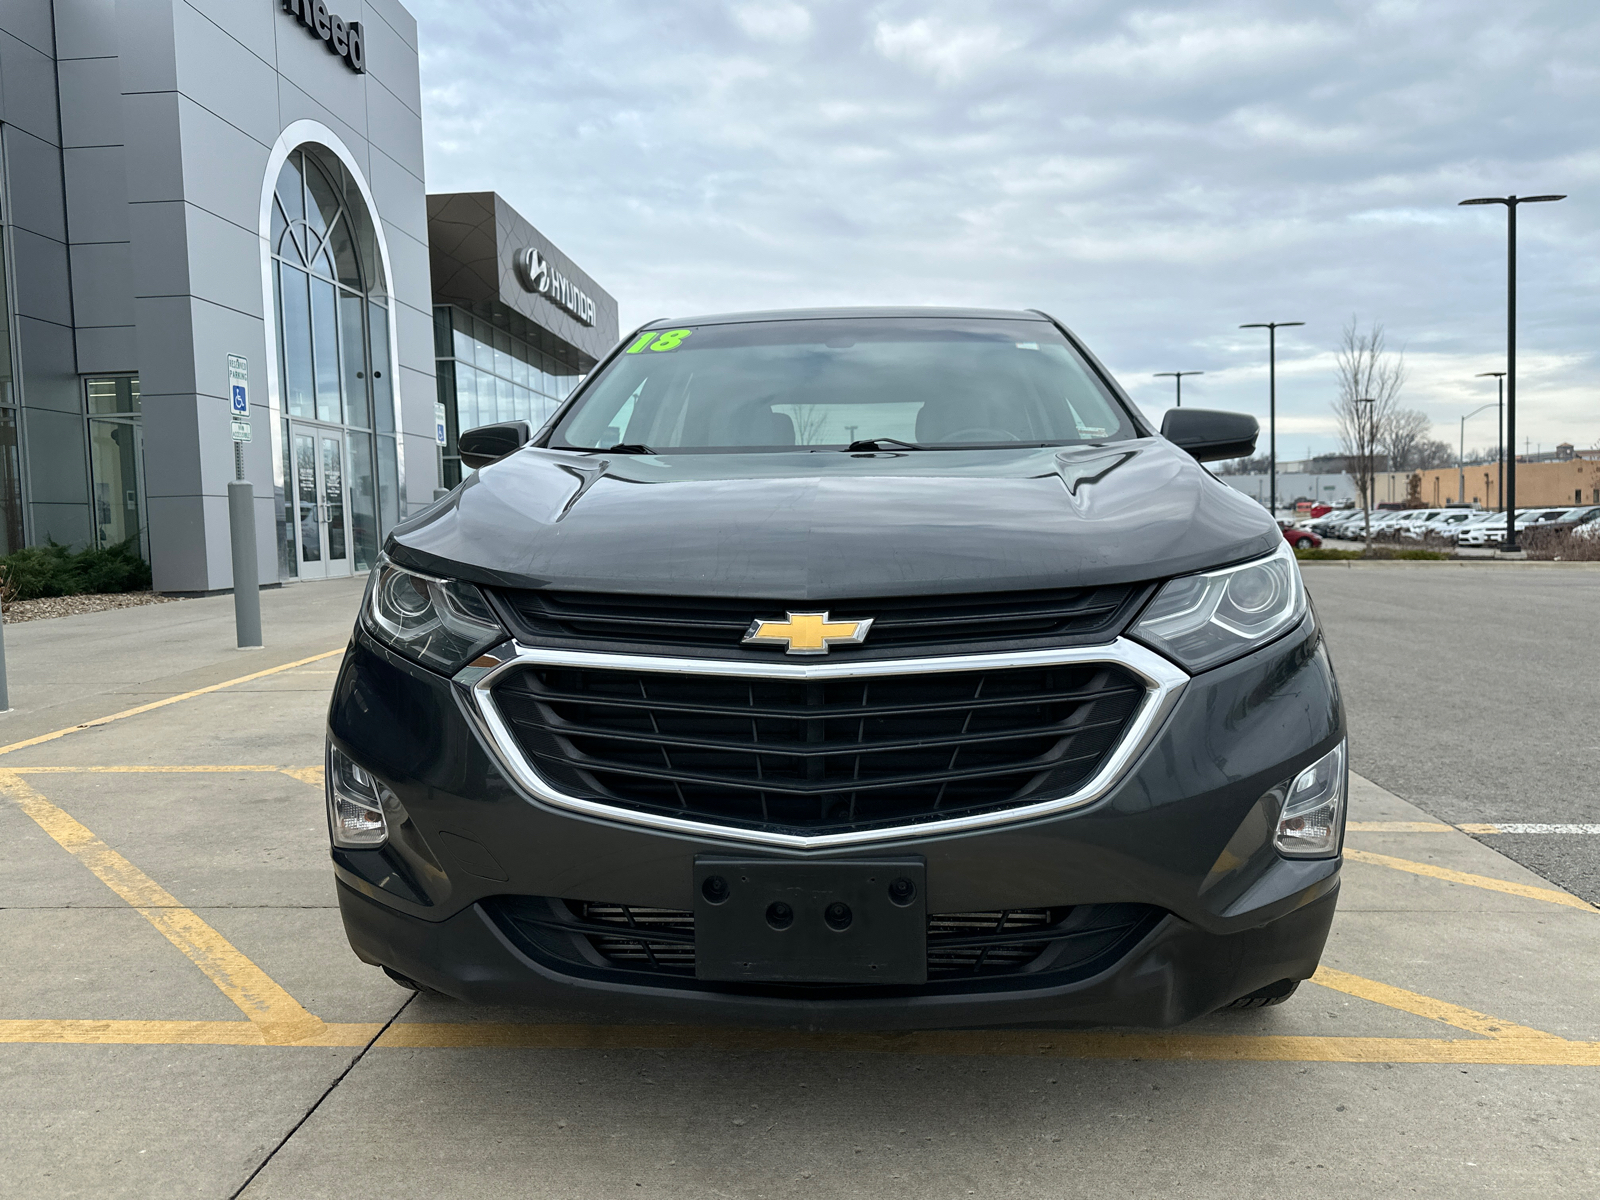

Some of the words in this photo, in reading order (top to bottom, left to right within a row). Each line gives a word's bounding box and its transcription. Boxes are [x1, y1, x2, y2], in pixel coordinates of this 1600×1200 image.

[550, 266, 597, 327] HYUNDAI
[626, 329, 692, 354] 18
[229, 369, 247, 381] PARKING
